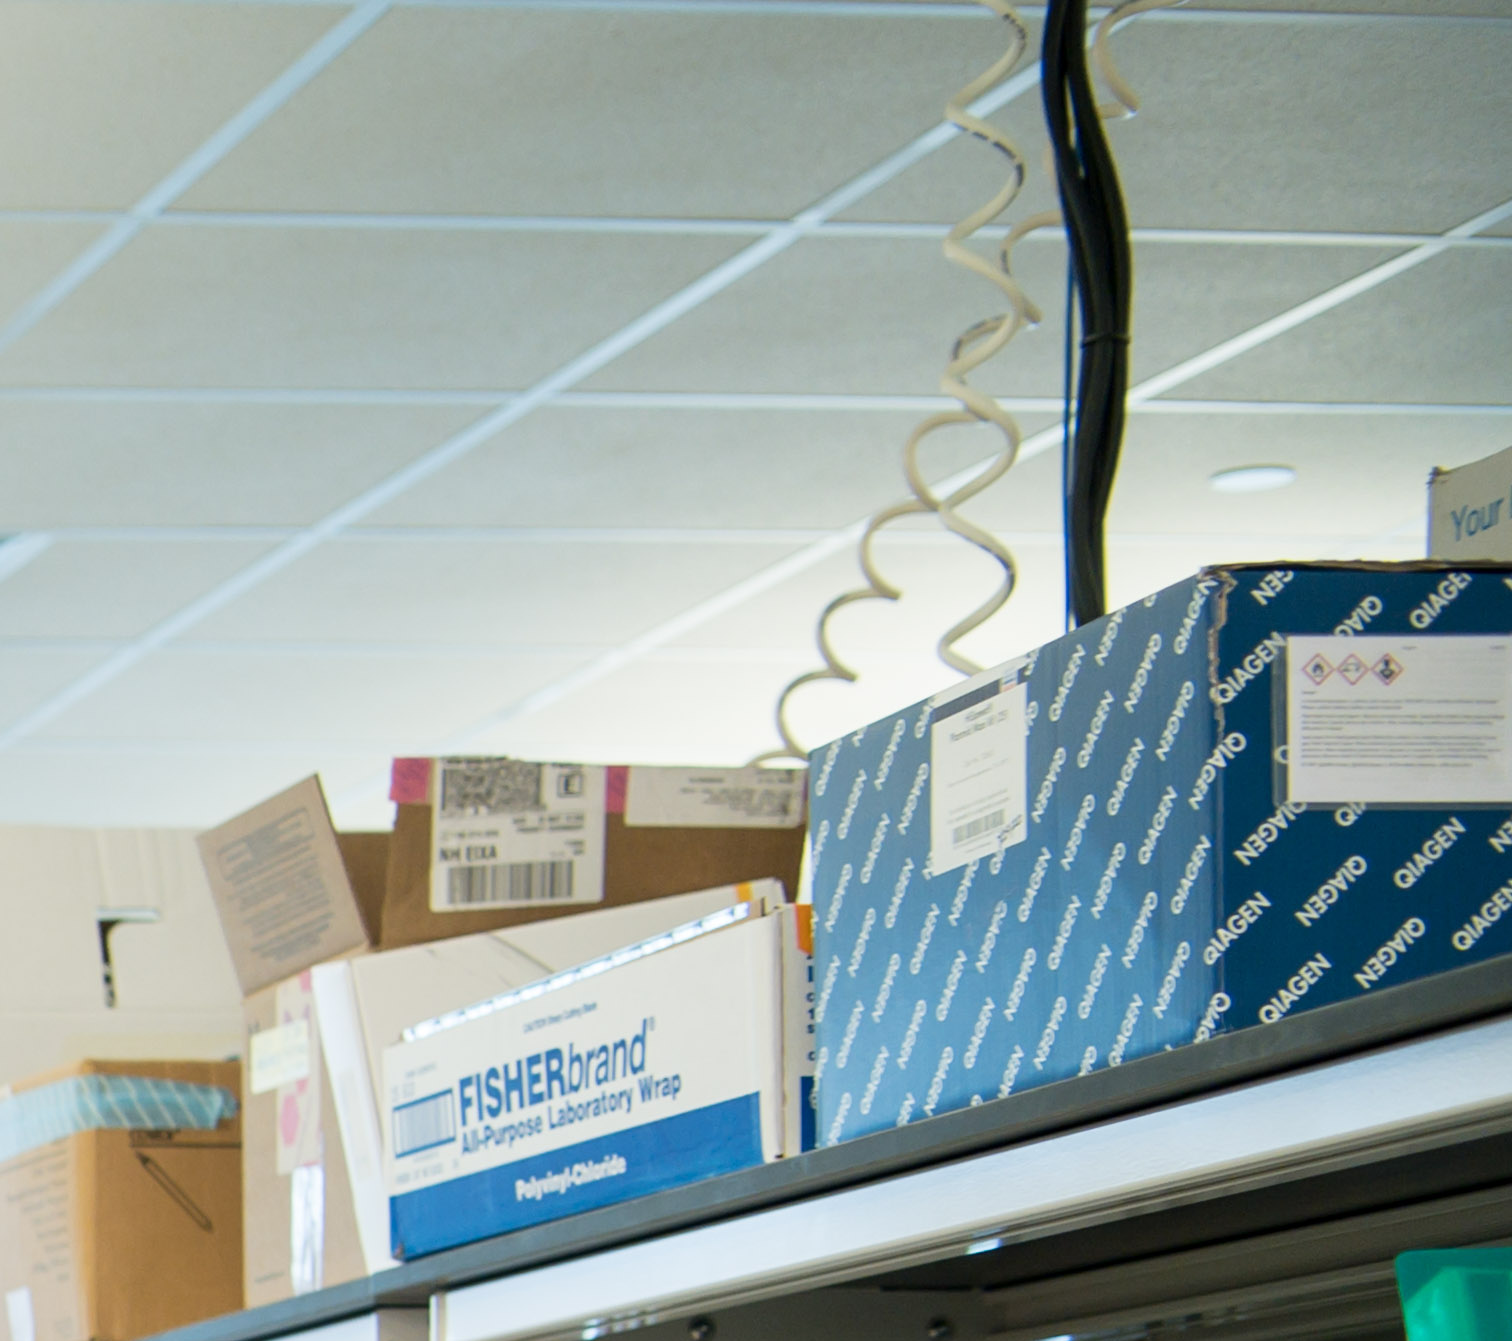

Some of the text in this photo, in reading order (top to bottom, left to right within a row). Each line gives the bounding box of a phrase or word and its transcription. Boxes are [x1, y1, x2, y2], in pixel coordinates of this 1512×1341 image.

[1450, 497, 1505, 542] Your
[1210, 631, 1289, 705] QIAGEN
[1189, 732, 1247, 810] QIAGEN
[1394, 816, 1466, 889] QIAGEN
[1294, 855, 1367, 928] QIAGEN
[1203, 891, 1271, 966] QIAGEN
[1353, 917, 1426, 989] QIAGEN
[1258, 952, 1332, 1024] QIAGEN
[462, 1072, 681, 1155] All-Purpose Laboratory Wrap
